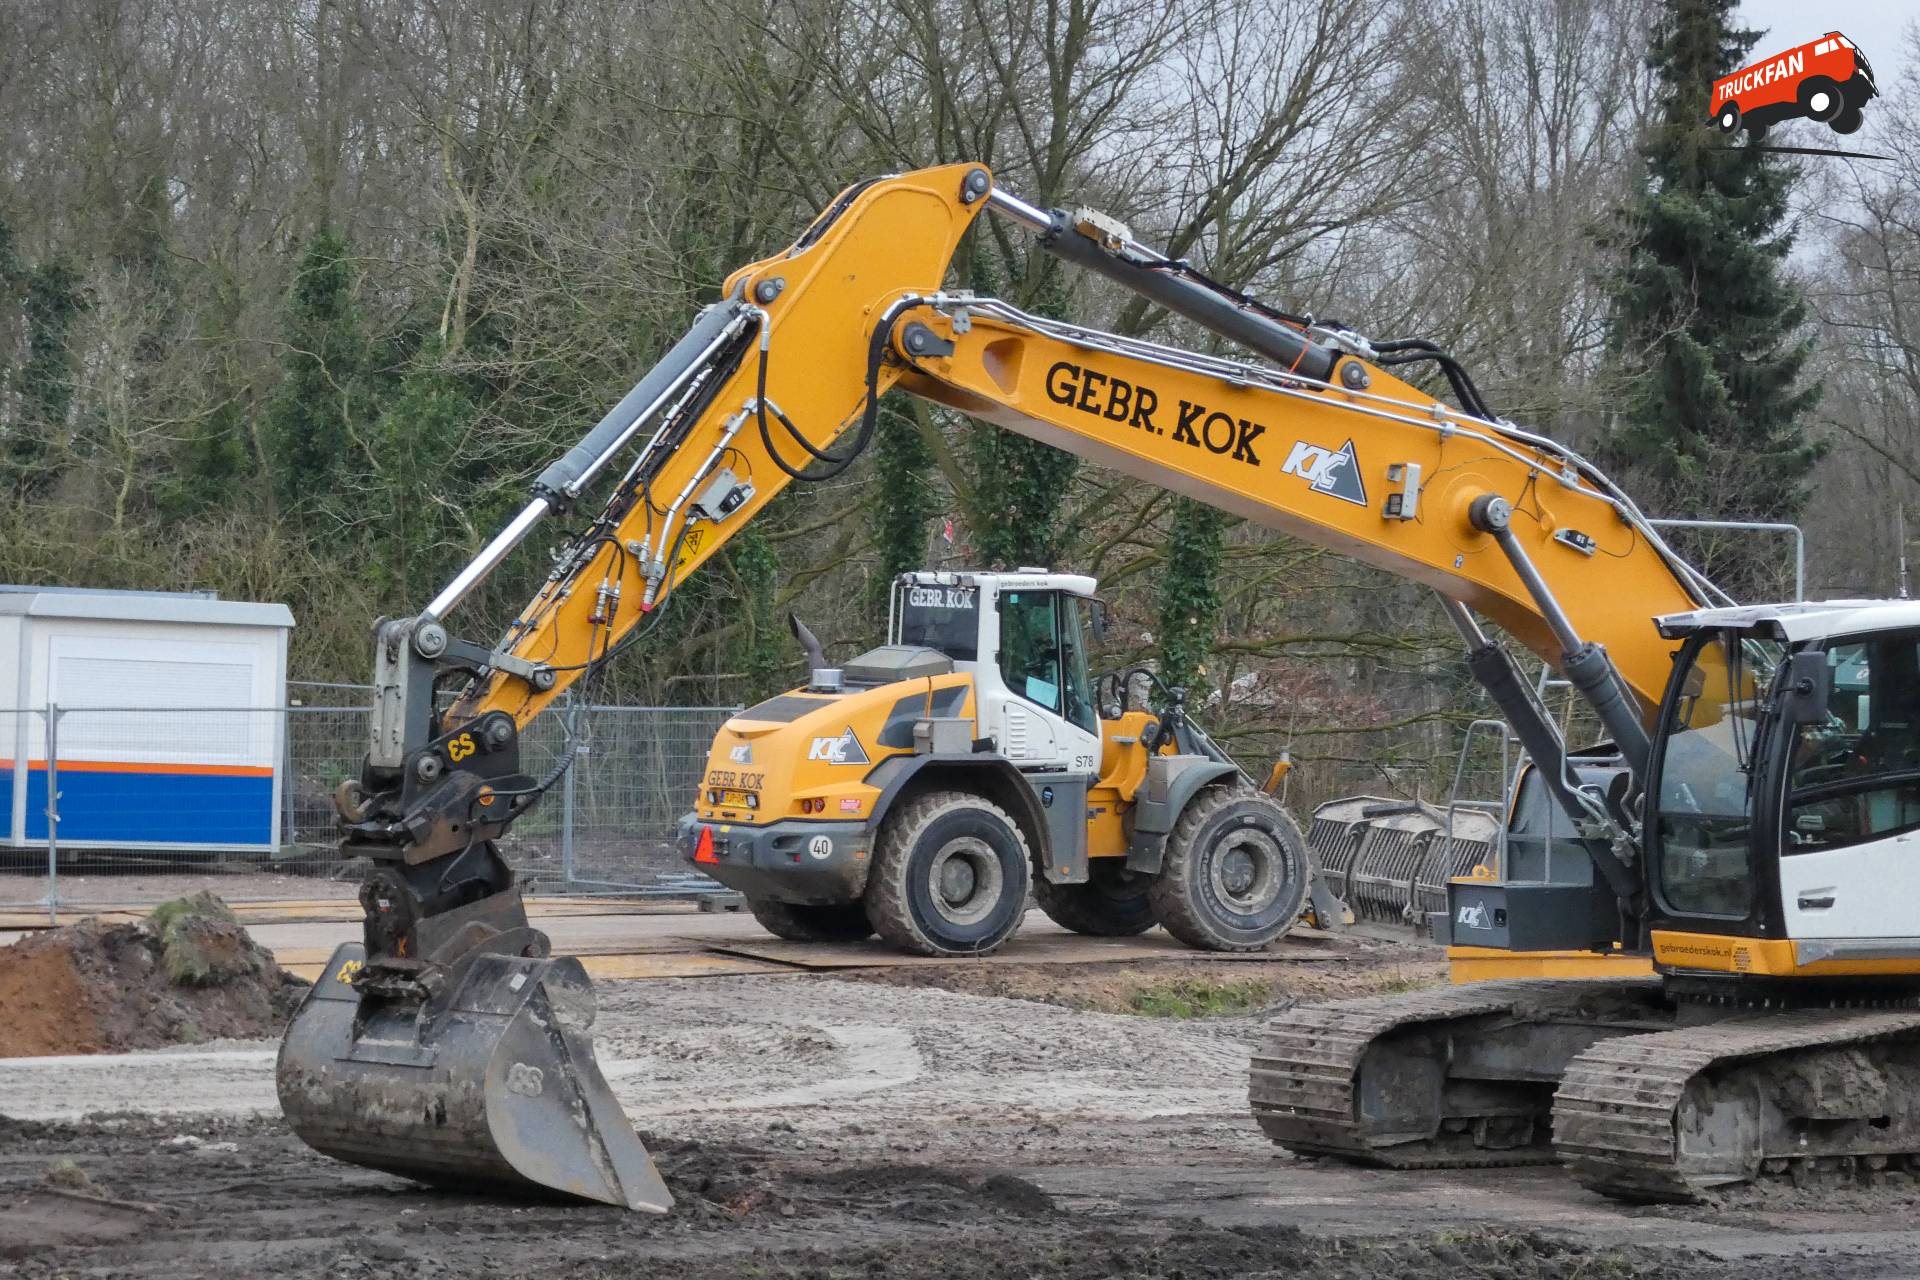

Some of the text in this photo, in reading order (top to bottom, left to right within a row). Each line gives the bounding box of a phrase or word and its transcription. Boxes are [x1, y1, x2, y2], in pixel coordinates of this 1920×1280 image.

[1046, 361, 1266, 466] GEBR. KOK
[946, 590, 973, 608] KOK
[1076, 756, 1093, 768] S78
[739, 772, 765, 790] KOK
[813, 840, 828, 855] 40
